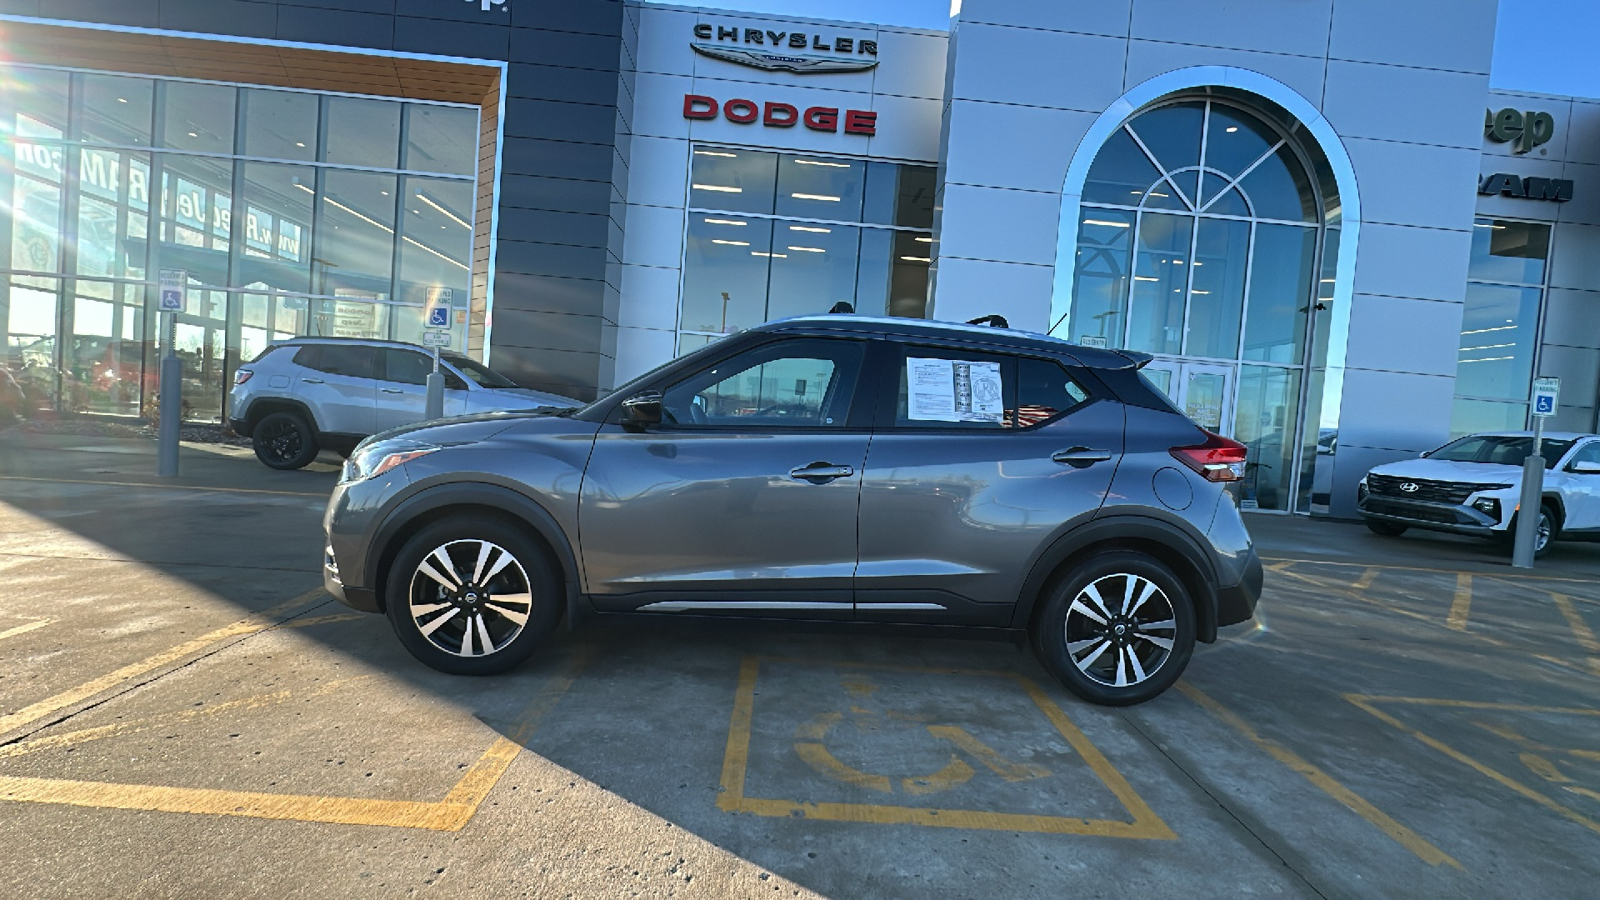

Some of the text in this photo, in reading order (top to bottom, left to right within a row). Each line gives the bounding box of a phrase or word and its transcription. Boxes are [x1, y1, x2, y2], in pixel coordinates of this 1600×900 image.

[694, 24, 879, 54] CHRYSLER
[683, 94, 878, 136] DODGE
[1477, 172, 1574, 202] AM
[427, 296, 451, 304] PAKING
